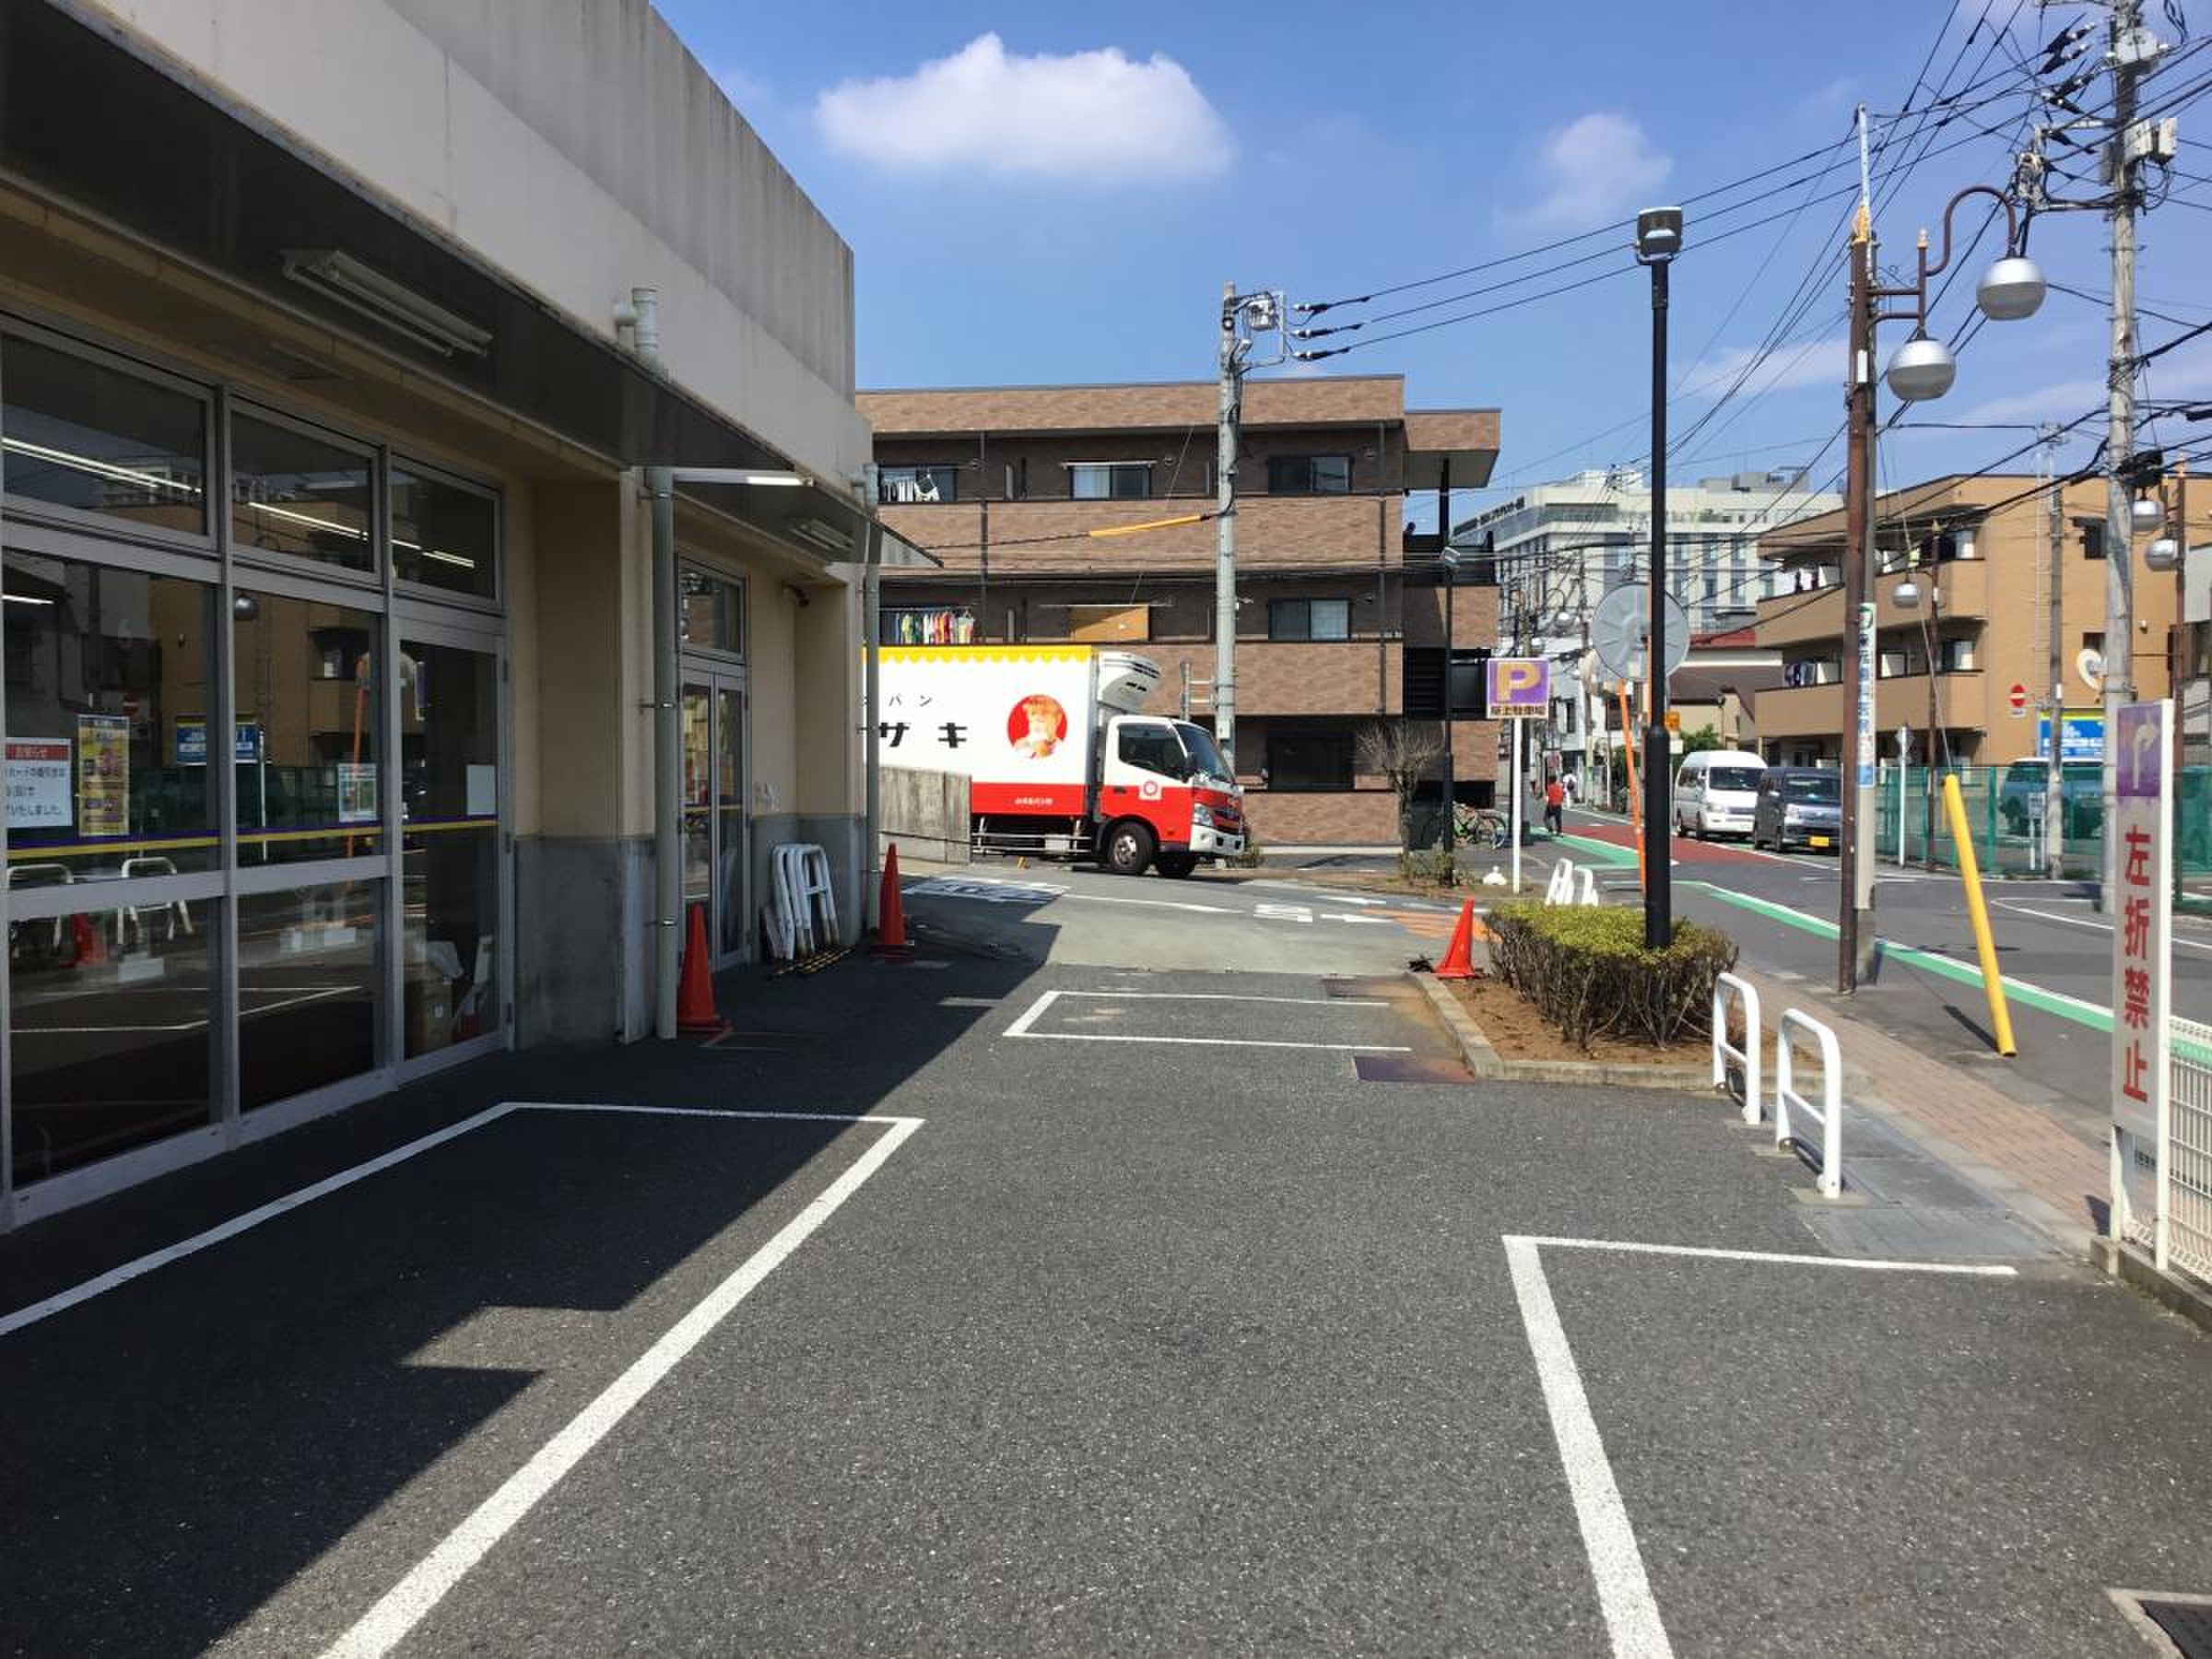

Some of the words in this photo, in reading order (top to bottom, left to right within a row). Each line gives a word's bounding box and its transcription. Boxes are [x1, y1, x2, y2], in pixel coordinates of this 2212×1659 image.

[1497, 662, 1540, 700] P
[2124, 824, 2151, 1102] 左折禁止
